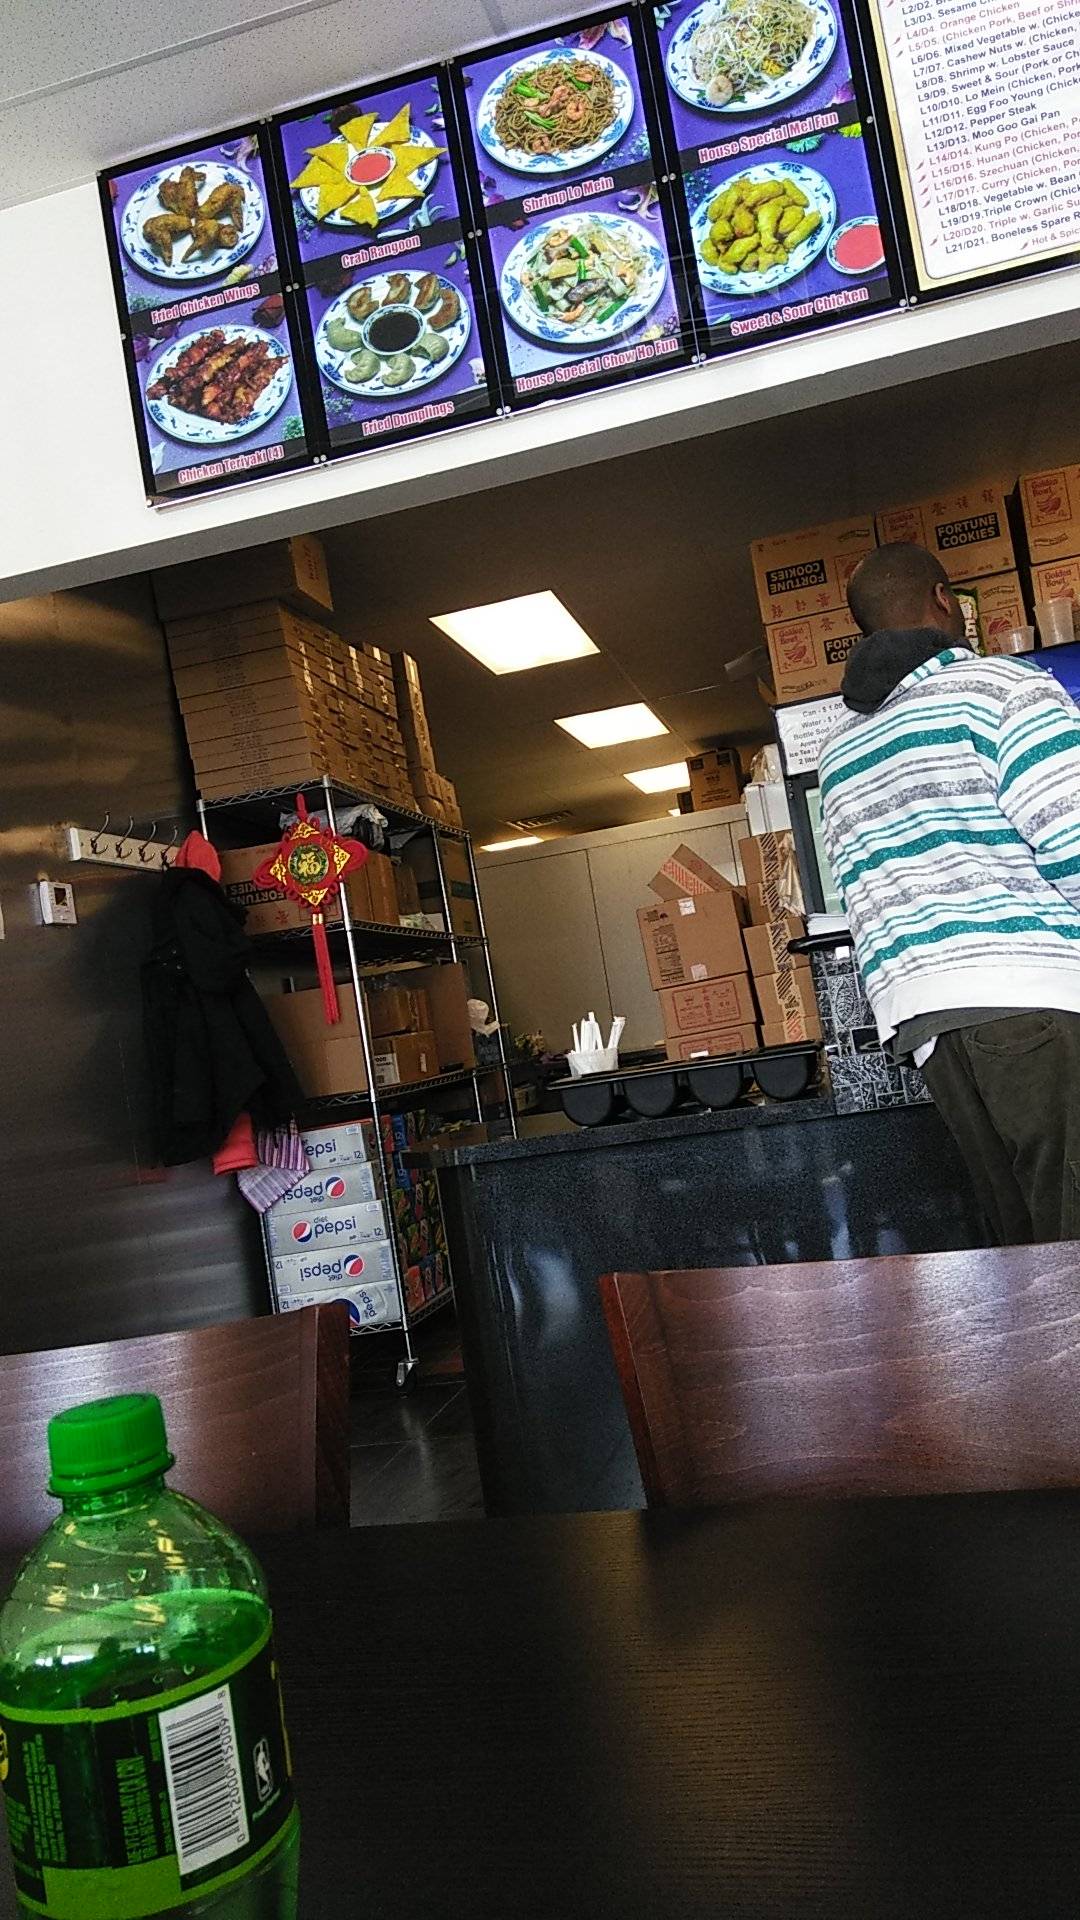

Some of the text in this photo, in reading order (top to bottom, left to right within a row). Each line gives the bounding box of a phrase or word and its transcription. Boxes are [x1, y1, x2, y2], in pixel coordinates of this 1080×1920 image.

[903, 2, 932, 14] L2/D2.
[905, 14, 934, 27] L3/D3.
[937, 1, 976, 17] Sesame
[940, 14, 976, 30] Orange
[979, 1, 1019, 18] Chicken
[910, 39, 939, 52] L5/D5.
[941, 24, 986, 43] (Chicken
[1018, 7, 1041, 19] Beef
[1043, 4, 1054, 12] or
[912, 52, 941, 64] L6/D6.
[944, 40, 973, 55] Mixed
[976, 26, 1025, 46] Vegetable
[1028, 22, 1039, 30] w.
[914, 64, 944, 77] L7/D7.
[946, 49, 986, 67] Cashew
[989, 43, 1012, 55] Nuts
[1028, 25, 1077, 44] (Chicken,
[917, 76, 946, 89] L8/D8.
[949, 63, 985, 80] Shrimp
[1001, 48, 1040, 65] Lobster
[1042, 38, 1074, 52] Sauce
[951, 77, 982, 92] Sweet
[984, 74, 991, 82] &
[994, 67, 1019, 80] Sour
[1021, 57, 1048, 73] (Pork
[1051, 54, 1061, 63] or
[921, 98, 962, 114] L10/D10.
[965, 91, 978, 102] Lo
[981, 85, 1004, 97] Mein
[1007, 71, 1055, 90] (Chicken,
[924, 111, 963, 127] L11/D11.
[966, 103, 986, 116] Egg
[989, 97, 1008, 108] Foo
[1010, 87, 1043, 103] Young
[698, 112, 839, 163] House Special Mei Fun
[925, 102, 1036, 139] L12/D12. Pepper Steak
[928, 109, 1060, 152] L13/D13. Moo Goo Gai Pan
[930, 148, 972, 165] L14/D14.
[974, 139, 1001, 154] Kung
[1004, 134, 1017, 144] Po
[1020, 121, 1068, 140] (Chicken,
[932, 161, 974, 178] L15/D15.
[977, 150, 1009, 165] Hunan
[1012, 137, 1060, 156] (Chicken,
[935, 174, 976, 191] L16/D16.
[979, 158, 1028, 178] Szechuan
[937, 187, 979, 203] L17/D17.
[981, 176, 1010, 192] Curry
[1012, 164, 1060, 183] (Chicken,
[523, 177, 614, 213] Shrimp Lo Mein
[939, 173, 1076, 216] L18/D18. Vegetable w. Bean
[1014, 194, 1047, 209] Crown
[944, 225, 986, 241] L20/D20.
[989, 215, 1017, 229] Triple
[1033, 203, 1063, 217] Garlic
[946, 237, 988, 254] L21/D21.
[991, 223, 1038, 242] Boneless
[1040, 215, 1070, 229] Spare
[1031, 226, 1080, 245] Hot & Spic
[341, 235, 420, 268] Crab Rangoon
[151, 284, 260, 324] Fried Chicken Wings
[731, 288, 869, 336] Sweet & Sour Chicken
[516, 338, 678, 393] House Special Chow Ho Fun
[362, 401, 454, 436] Fried Dumplings
[178, 445, 284, 484] Chicken Teriyaki (4)
[937, 514, 997, 537] FORTUNE
[941, 526, 996, 548] COOKIES
[769, 572, 825, 593] FORTUNE
[770, 562, 820, 582] COOKIES
[1044, 568, 1072, 580] Golden
[793, 731, 814, 740] Bottle
[802, 719, 821, 728] Water
[282, 1182, 324, 1204] pepsi
[314, 1216, 357, 1239] pepsi
[374, 1227, 383, 1236] 12
[300, 1259, 342, 1281] pepsi
[219, 1717, 235, 1765] 15009
[226, 1768, 243, 1816] 12000
